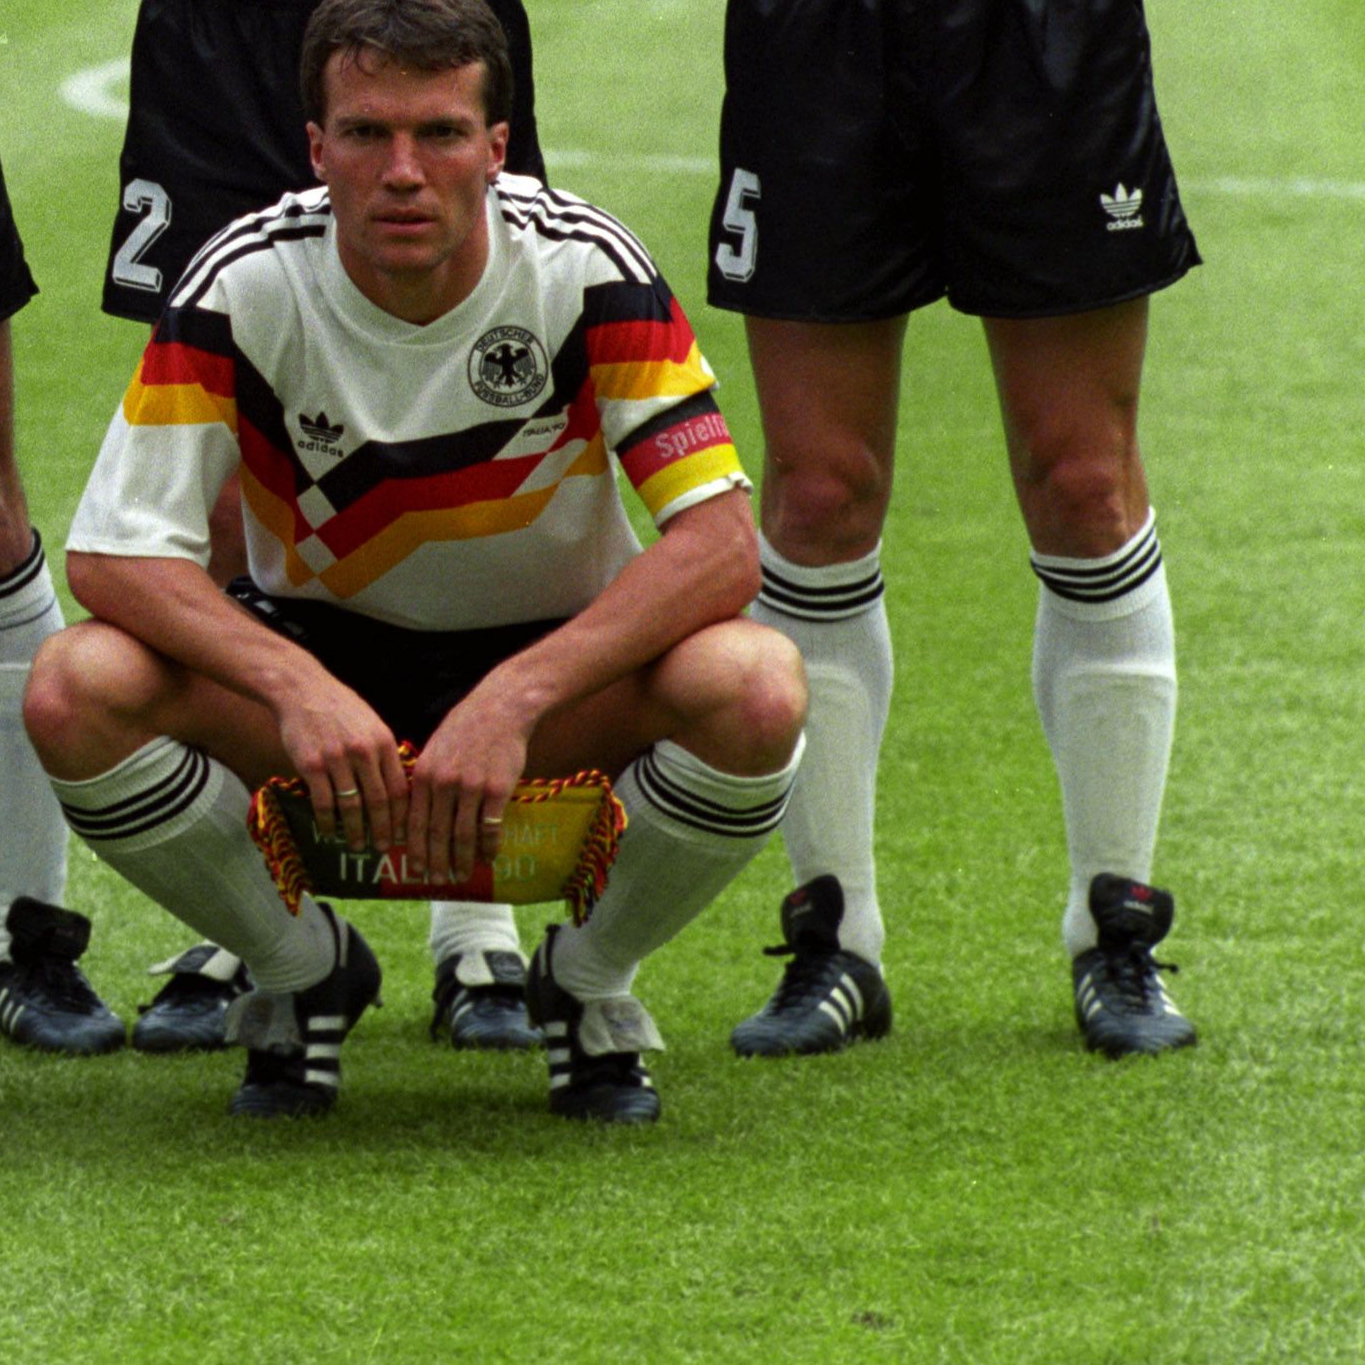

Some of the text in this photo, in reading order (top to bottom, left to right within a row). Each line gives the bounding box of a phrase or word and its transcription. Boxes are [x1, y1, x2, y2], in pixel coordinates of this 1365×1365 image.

[112, 178, 172, 293] 2
[716, 167, 762, 282] 5
[475, 327, 534, 353] DEUTSCHER
[298, 438, 344, 459] adidas
[339, 852, 456, 884] ITAL
